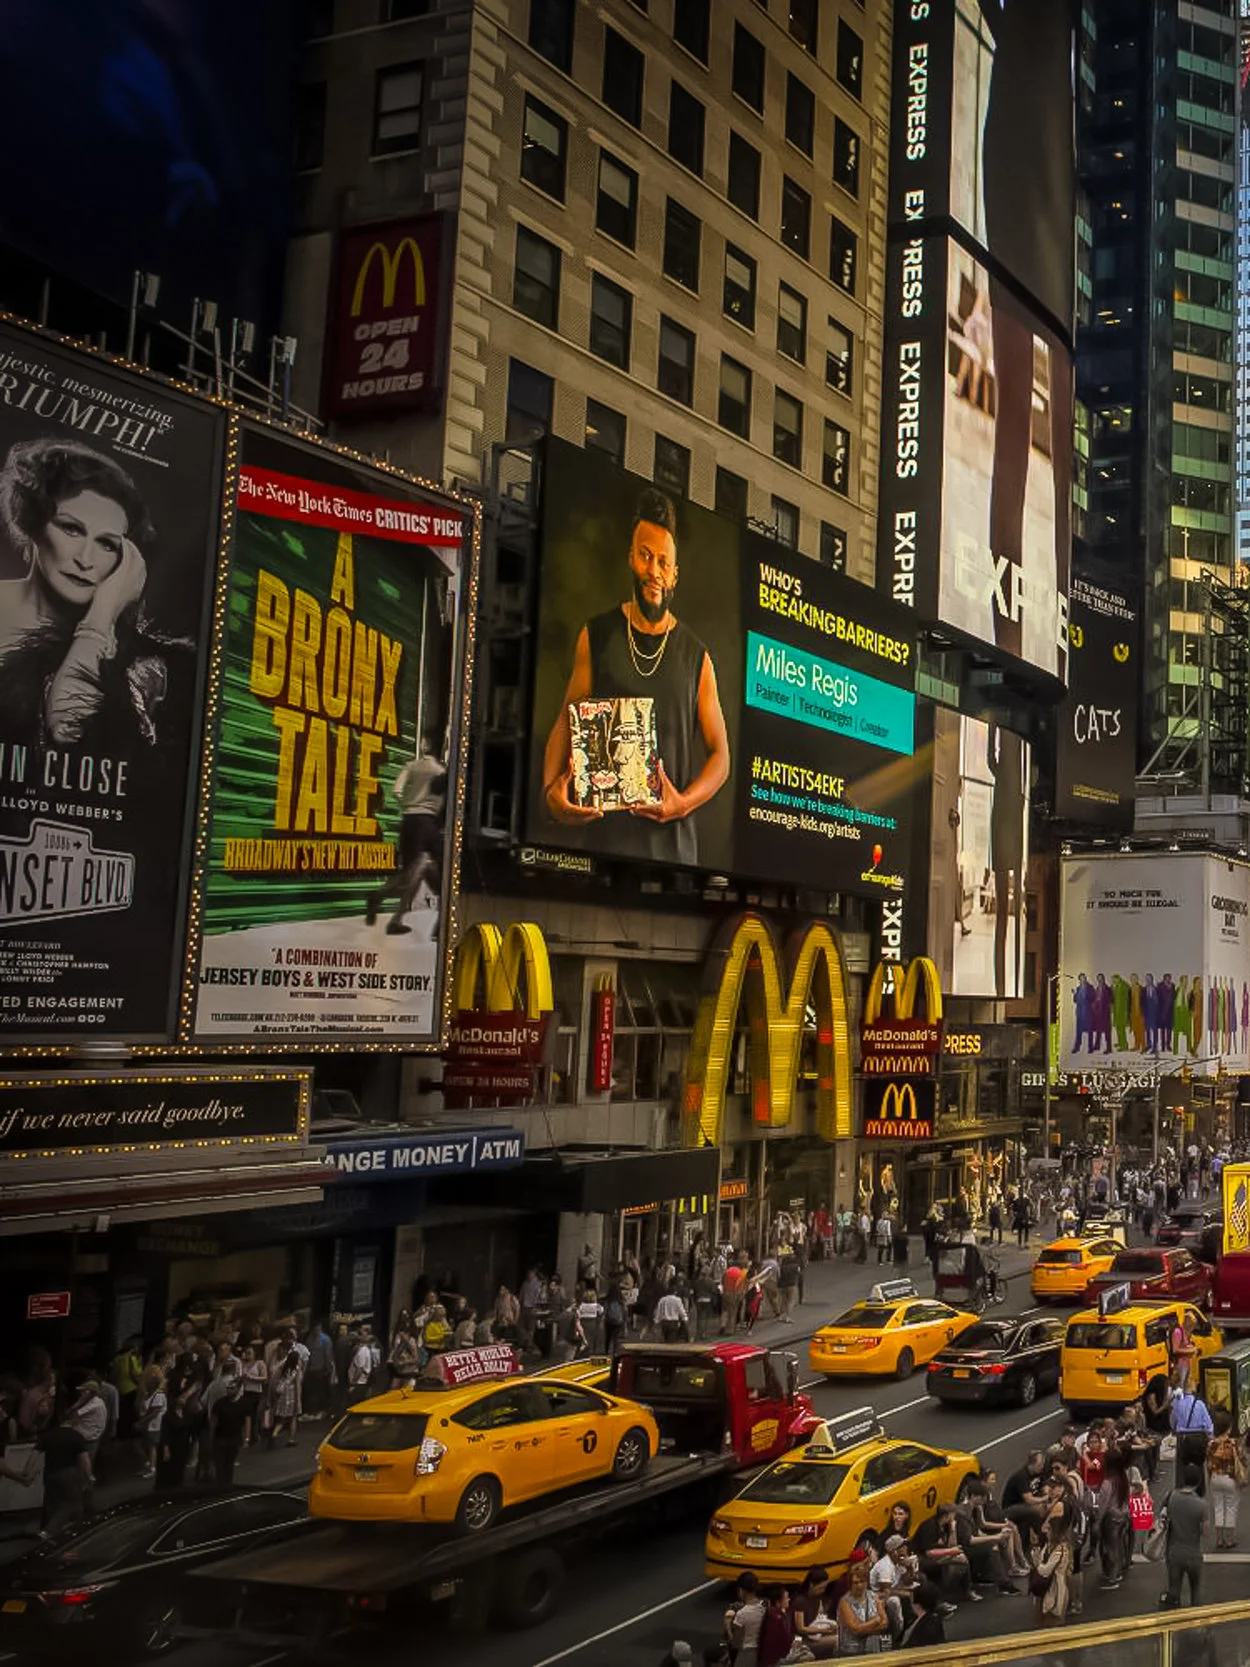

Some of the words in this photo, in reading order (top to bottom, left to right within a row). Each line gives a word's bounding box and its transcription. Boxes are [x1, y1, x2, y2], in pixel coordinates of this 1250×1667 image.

[906, 42, 928, 161] EXPRESS
[354, 315, 419, 340] OPEN
[359, 338, 410, 374] 24
[341, 372, 424, 400] HOURS
[896, 341, 921, 479] EXPRESS
[239, 475, 264, 498] The
[266, 482, 296, 507] New
[297, 489, 332, 515] York
[332, 497, 373, 523] Times
[375, 507, 431, 535] CRITICS'
[433, 519, 463, 538] PICK
[331, 532, 354, 611] A
[760, 562, 802, 596] WHO'S
[248, 567, 403, 737] BRONX
[756, 643, 806, 688] Miles
[811, 663, 858, 708] Regis
[1074, 704, 1122, 744] CATS
[44, 749, 128, 796] CLOSE
[271, 705, 382, 837] TALE
[751, 756, 846, 799] #ARTISTS4EKF
[55, 803, 124, 821] WEBBER'S
[750, 783, 770, 802] See
[770, 787, 791, 807] how
[223, 837, 310, 870] BROADWAY'S
[312, 841, 338, 870] NEW
[339, 841, 356, 869] HIT
[359, 842, 397, 869] MUSICAL
[81, 858, 128, 906] BLVD.
[1120, 890, 1142, 898] MUCH
[1086, 900, 1095, 909] IT
[286, 948, 361, 968] COMBINATION
[364, 953, 379, 969] OF
[200, 966, 259, 986] JERSEY
[262, 969, 301, 988] BOYS
[303, 971, 315, 989] &
[318, 972, 356, 990] WEST
[359, 974, 388, 991] SIDE
[27, 996, 125, 1010] ENGAGEMENT
[862, 1028, 939, 1042] McDonald's
[1021, 1073, 1068, 1087] GIFS
[0, 1108, 23, 1136] if
[23, 1112, 55, 1130] we
[57, 1107, 116, 1129] never
[119, 1101, 165, 1125] said
[162, 1099, 246, 1129] goodbye.
[391, 1142, 470, 1169] MONEY
[478, 1139, 520, 1161] ATM
